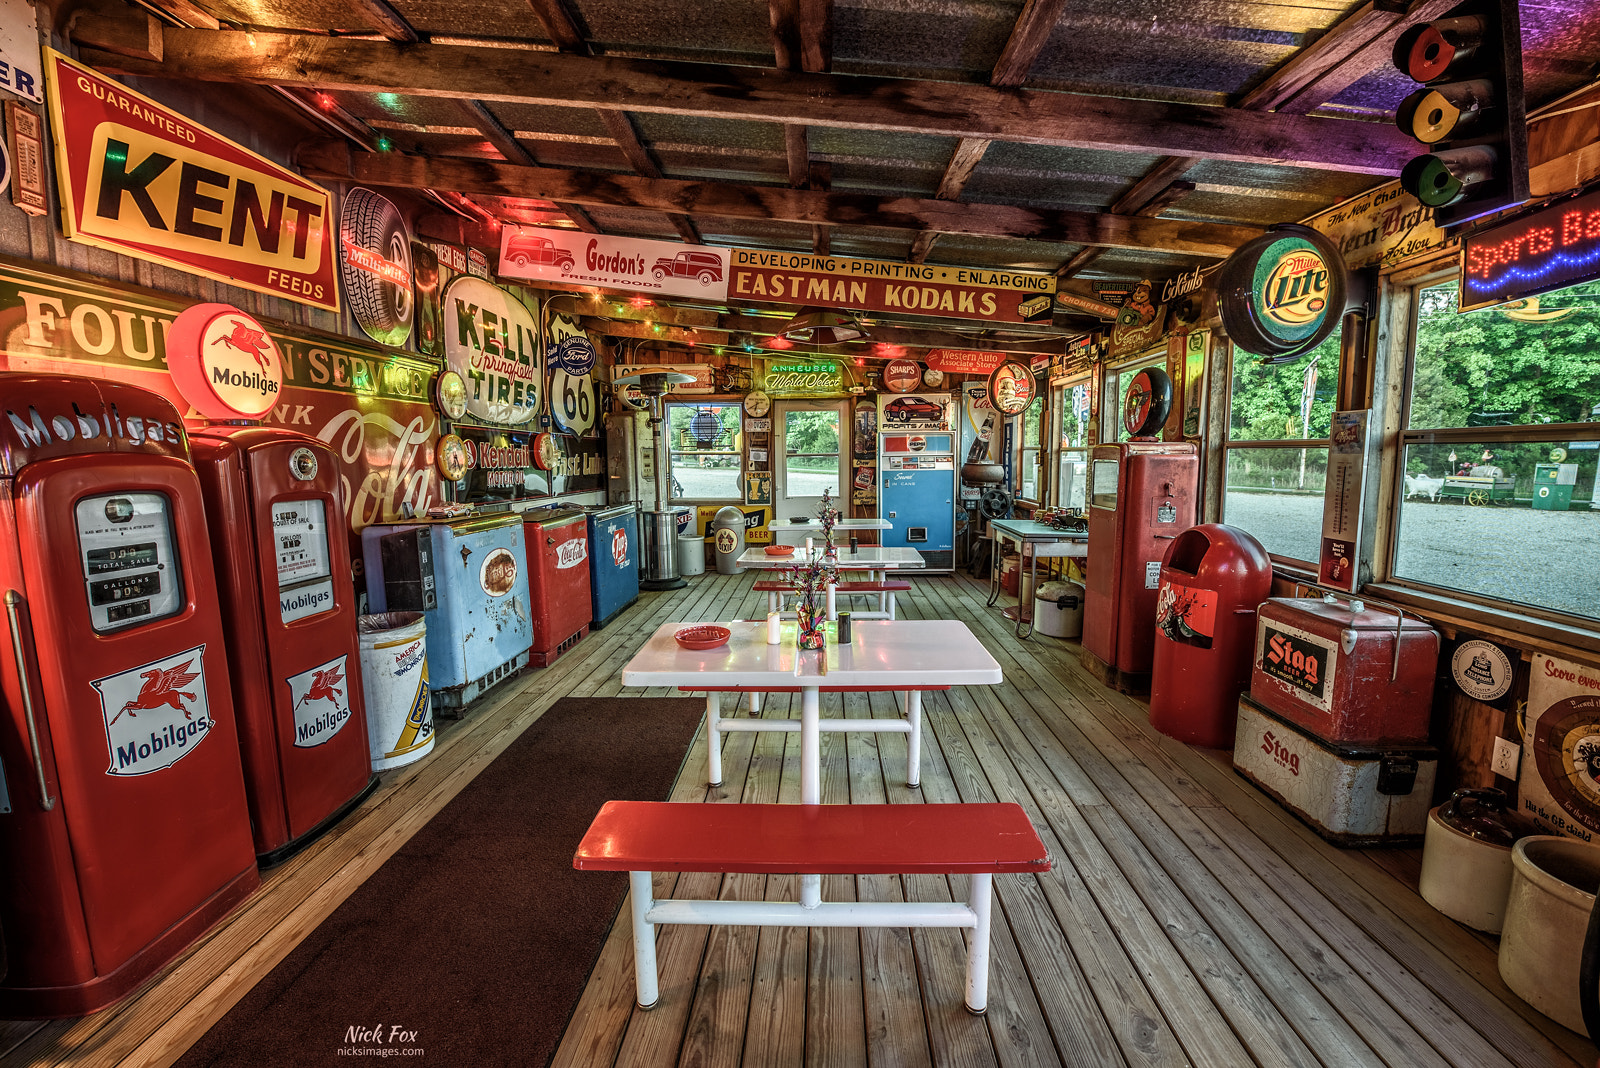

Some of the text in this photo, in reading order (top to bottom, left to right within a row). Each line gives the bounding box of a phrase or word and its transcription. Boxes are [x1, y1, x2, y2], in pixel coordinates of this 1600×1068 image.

[77, 76, 196, 143] GUARANTEED
[96, 137, 322, 260] KENT
[1328, 213, 1346, 227] The
[1347, 202, 1371, 219] New
[435, 244, 452, 265] FRESH
[586, 238, 645, 276] Gordon's
[1406, 237, 1430, 254] You
[1468, 227, 1554, 278] Sports
[350, 248, 409, 285] Multi-Mile
[738, 252, 1049, 290] DEVELOPING PRINTING ENLARGING
[1285, 257, 1321, 272] Miller
[267, 269, 325, 299] FEEDS
[561, 273, 662, 288] FRESH FOODS
[1270, 269, 1328, 308] Lite
[736, 272, 998, 316] EASTMAN KODAKS
[1063, 295, 1100, 311] CHOMPER
[454, 298, 538, 368] KELLY
[563, 337, 590, 349] GENUINE
[471, 340, 534, 386] Springfield
[563, 349, 590, 361] Ford
[939, 358, 974, 368] Associate
[975, 361, 997, 369] Store
[941, 350, 977, 362] Western
[977, 353, 998, 363] Auto
[213, 366, 279, 396] Mobilgas
[308, 348, 424, 398] SERVICE
[566, 366, 589, 375] PARTS
[764, 372, 842, 389] World Select
[468, 369, 537, 409] TIRES
[562, 374, 590, 423] 66
[6, 401, 183, 449] Mobilgas
[480, 442, 529, 468] Kendall
[487, 471, 526, 486] MOTOR OIL
[749, 531, 769, 539] BEER
[98, 561, 125, 570] TOTAL
[130, 557, 151, 565] SALE
[103, 577, 149, 590] GALLONS
[280, 591, 330, 613] Mobilgas
[395, 641, 421, 663] AMERICA
[1267, 632, 1318, 684] Stag
[1284, 665, 1300, 677] BEER
[1544, 659, 1576, 683] Score
[297, 707, 348, 742] Mobilgas
[116, 715, 207, 768] Mobilgas
[1261, 730, 1299, 776] Stag
[1525, 799, 1537, 813] Hit
[1538, 807, 1550, 820] the
